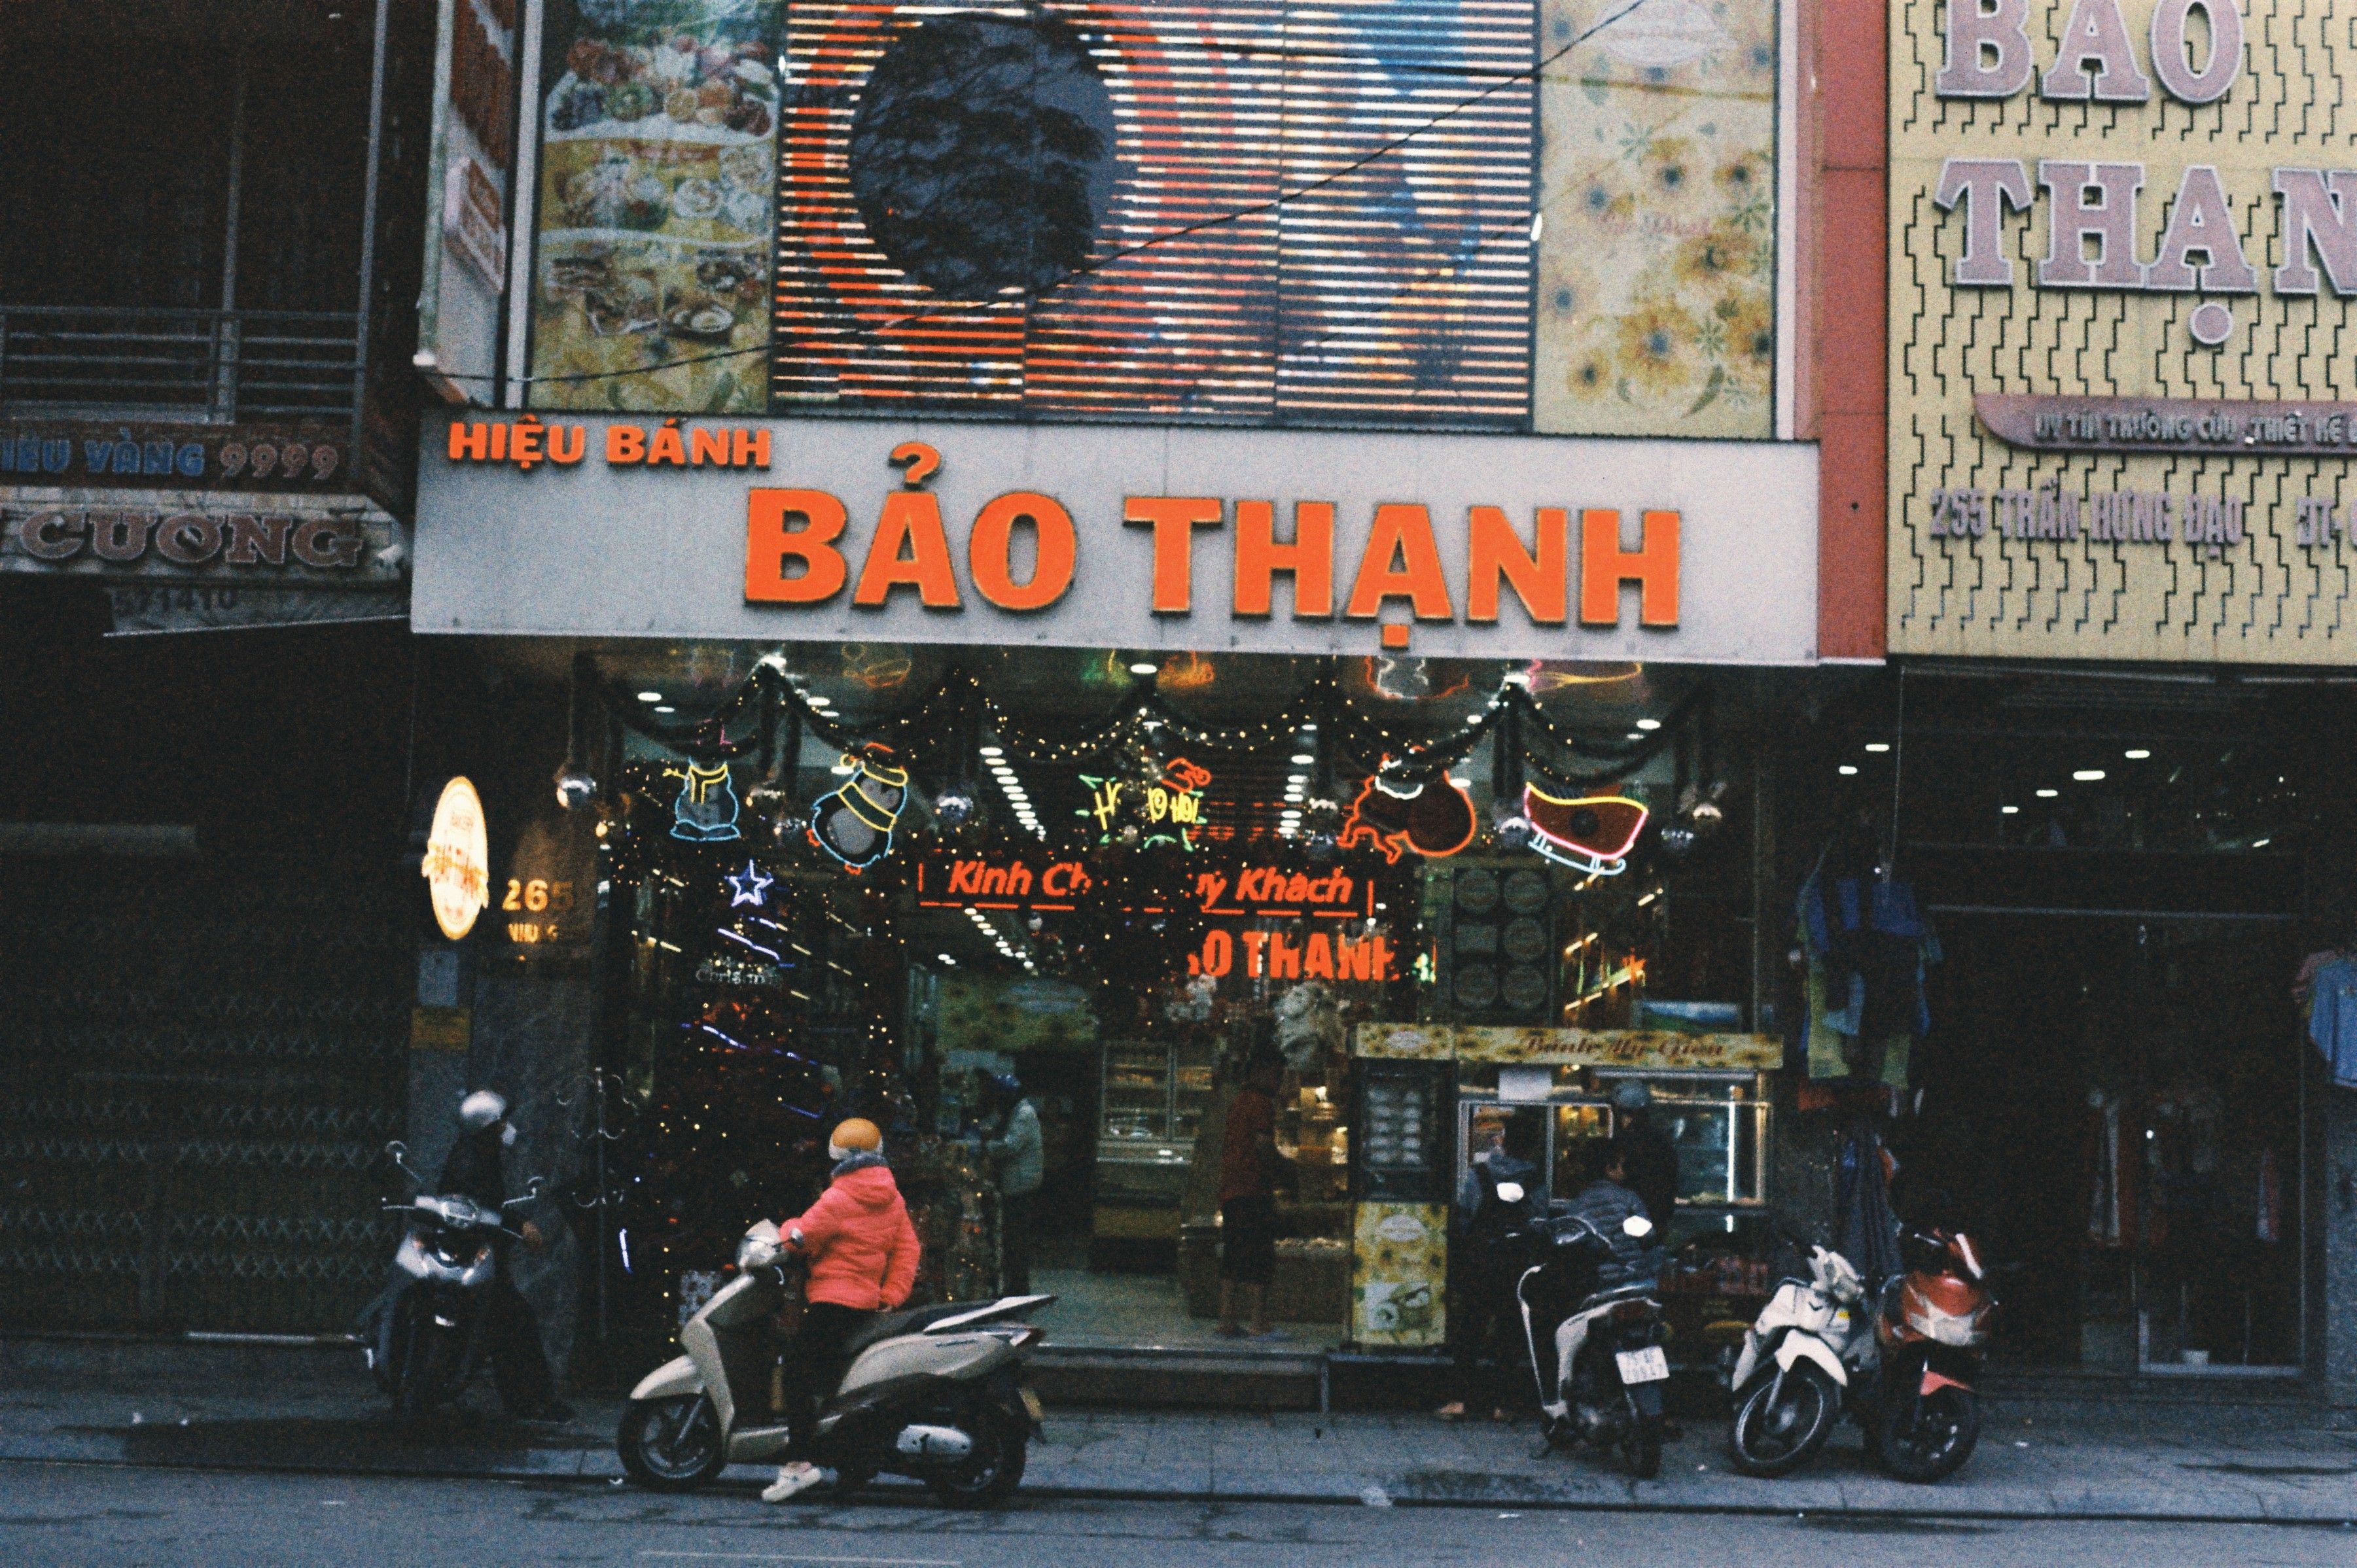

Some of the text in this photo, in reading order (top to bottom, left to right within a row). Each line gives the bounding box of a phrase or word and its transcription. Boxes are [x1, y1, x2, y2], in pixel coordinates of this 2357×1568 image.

[220, 442, 339, 479] 9999
[449, 414, 770, 468] HIỆU BÁNH
[1930, 488, 1987, 538] 255
[743, 441, 1681, 649] BẢO THẠNH
